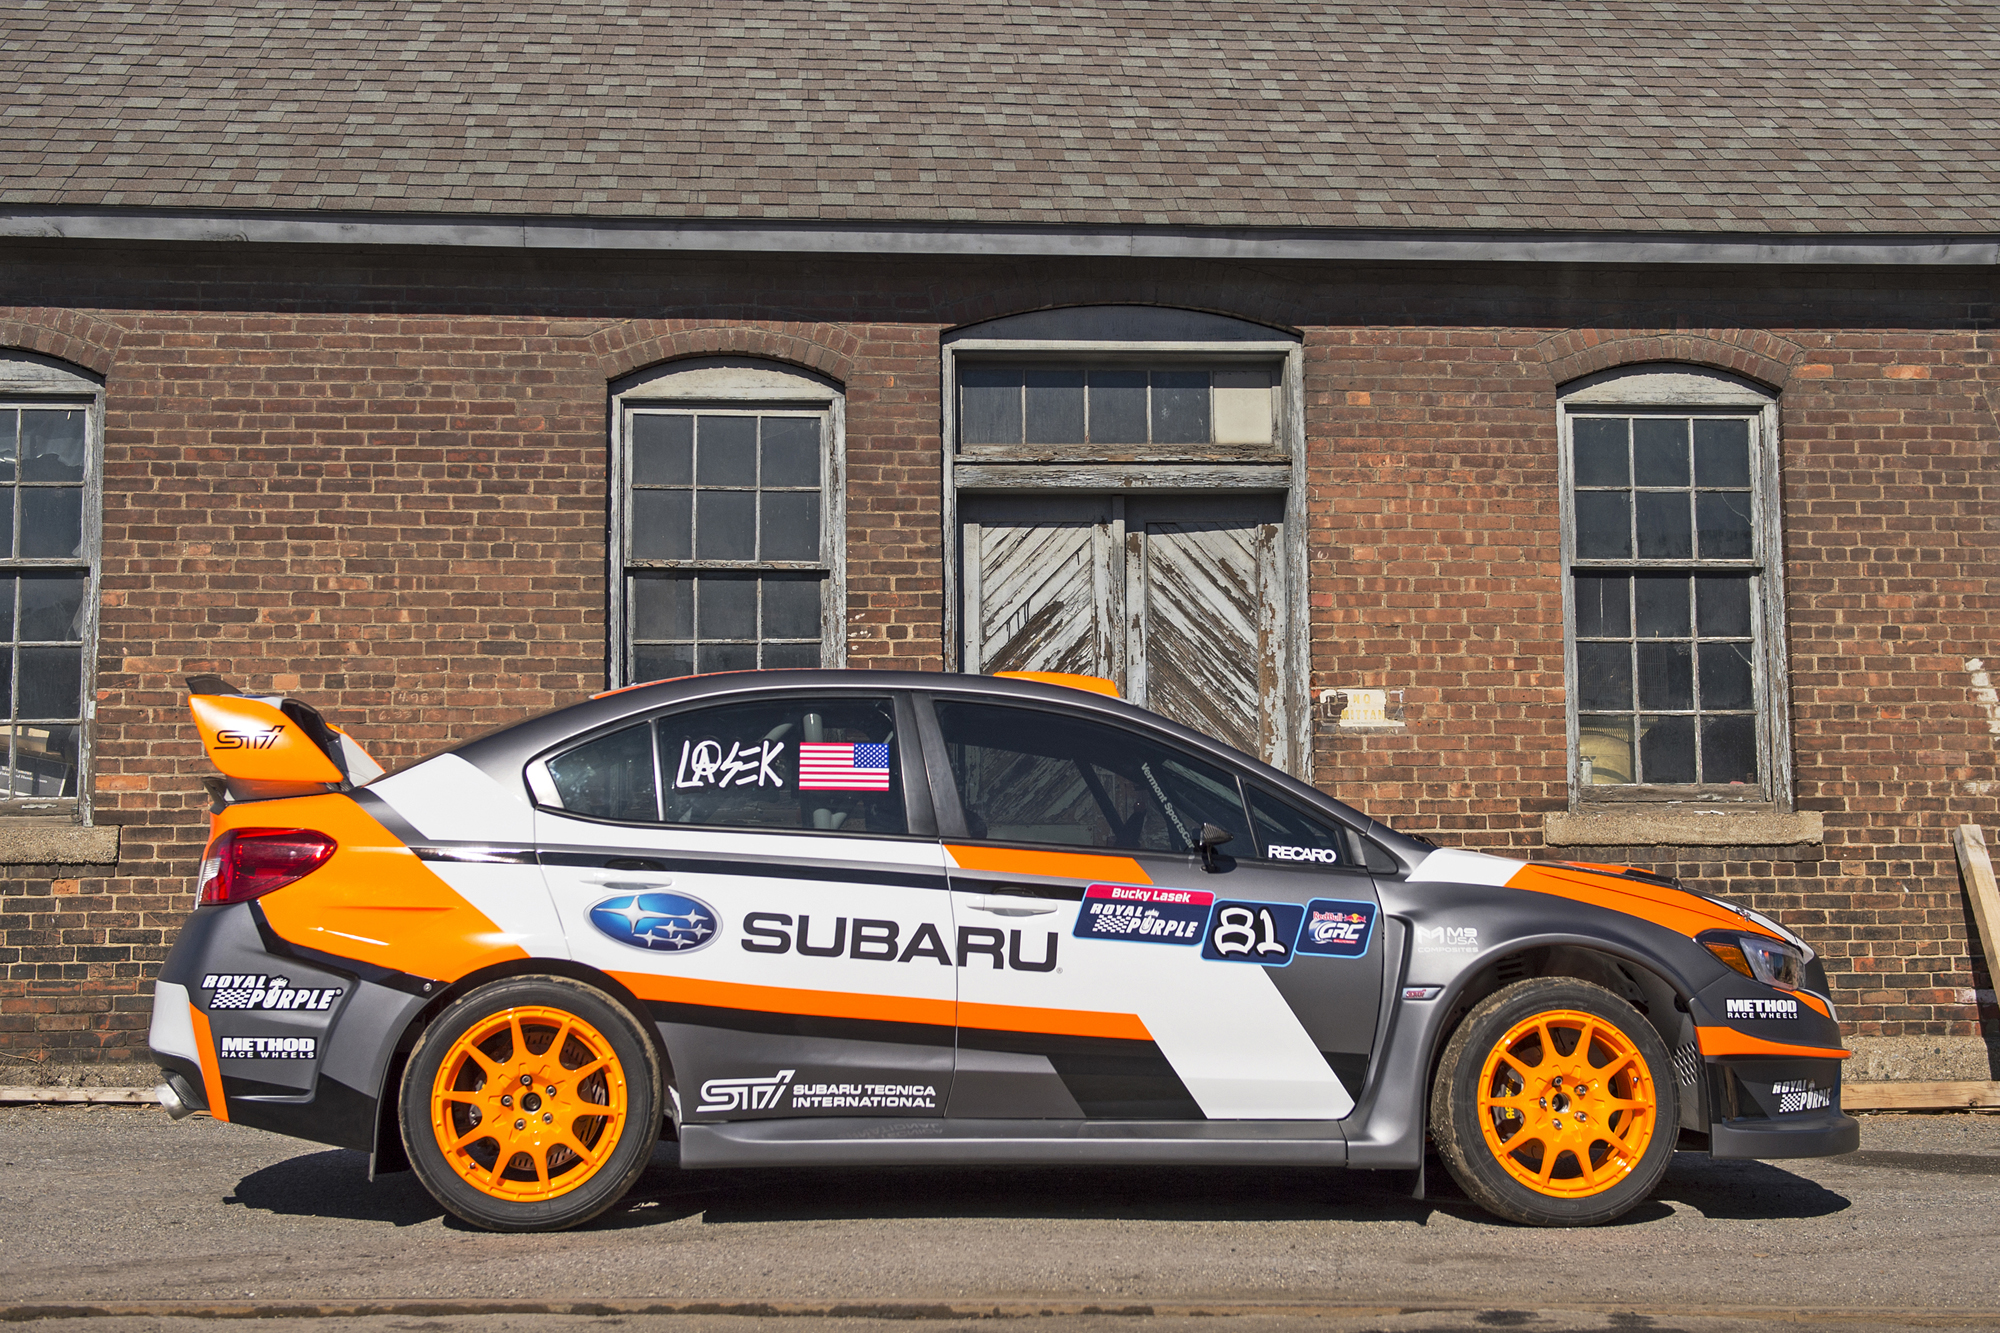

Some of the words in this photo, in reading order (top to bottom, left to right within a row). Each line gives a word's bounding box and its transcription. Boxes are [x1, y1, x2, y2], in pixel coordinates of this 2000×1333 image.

[1353, 694, 1370, 704] NO
[676, 740, 785, 788] LASEK
[1141, 762, 1168, 803] Vermont
[1268, 845, 1337, 863] RECARO
[1111, 888, 1151, 902] Bucky
[1152, 890, 1191, 903] Lasek
[1090, 903, 1143, 917] ROYAL
[1126, 917, 1198, 938] PURPLE
[1214, 907, 1286, 955] 81
[1318, 922, 1366, 940] GRC
[741, 911, 1059, 973] SUBARU
[1447, 937, 1479, 945] USA
[202, 975, 267, 988] ROYAL
[246, 989, 336, 1009] PURPLE
[1726, 1000, 1797, 1012] METHOD
[222, 1038, 315, 1051] METHOD
[792, 1084, 862, 1096] SUBARU
[864, 1085, 936, 1096] TECNICA
[1772, 1080, 1807, 1094] ROYAL
[792, 1097, 936, 1108] INTERNATIONAL
[1799, 1088, 1831, 1110] PURPLE
